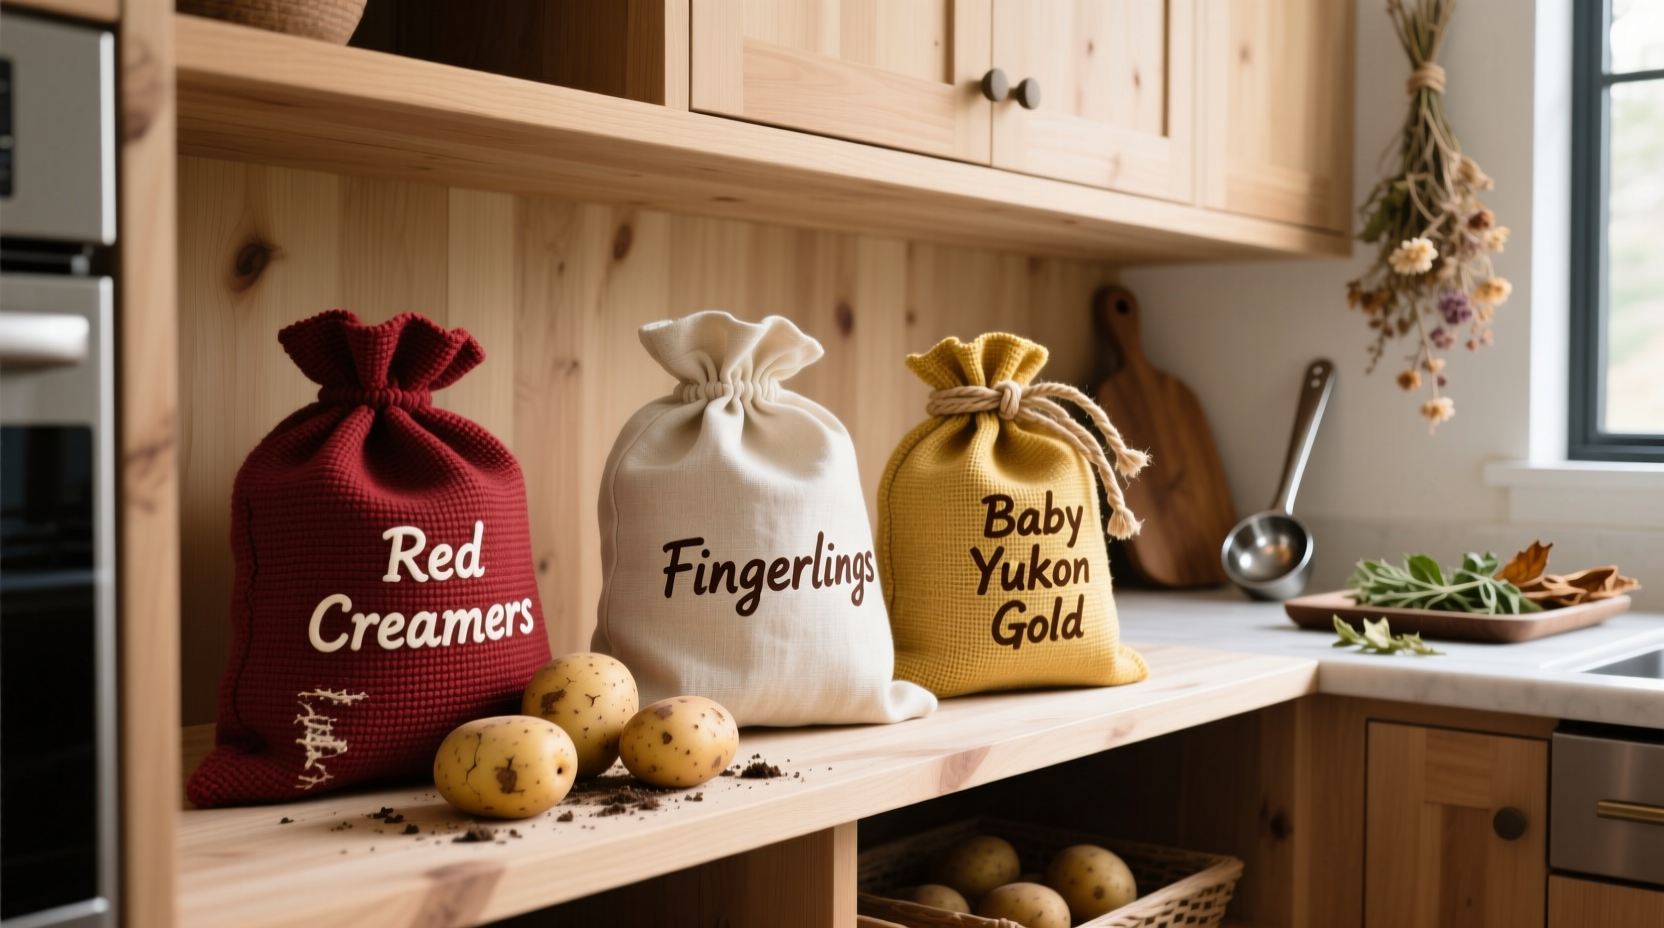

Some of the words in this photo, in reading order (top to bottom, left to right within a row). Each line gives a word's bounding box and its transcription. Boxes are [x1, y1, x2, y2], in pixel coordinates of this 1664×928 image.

[981, 490, 1084, 548] Baby
[382, 520, 486, 582] Red
[662, 530, 875, 617] Fingerlings
[969, 543, 1090, 596] Yukon
[308, 593, 535, 653] Creamers
[990, 593, 1085, 650] Gold
